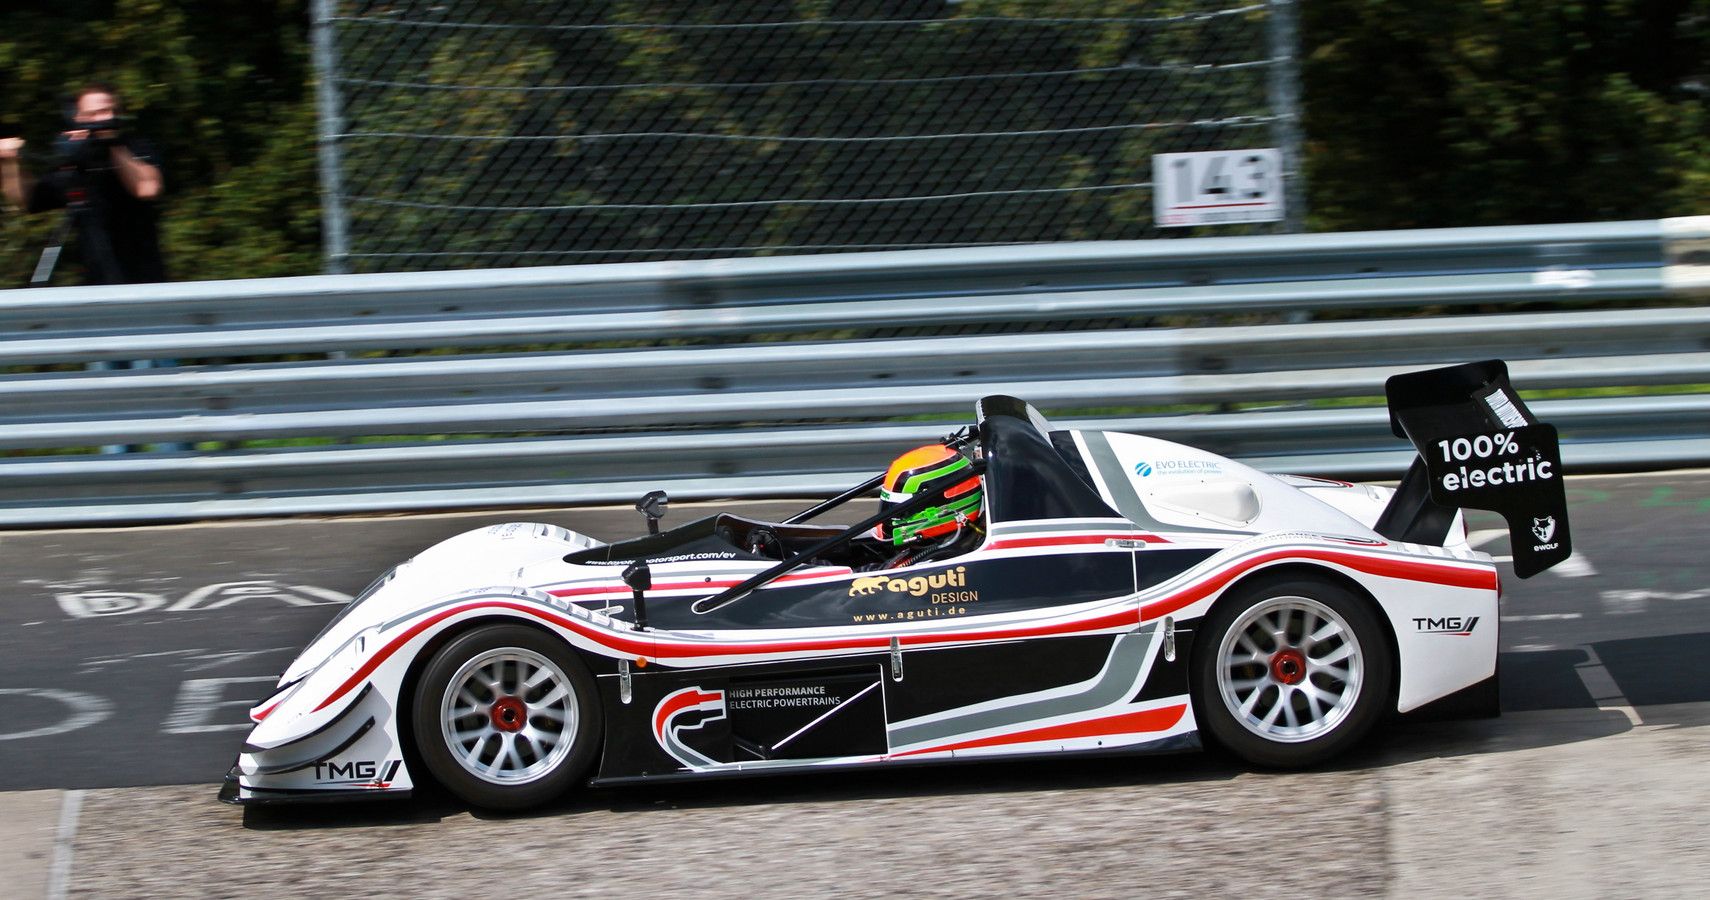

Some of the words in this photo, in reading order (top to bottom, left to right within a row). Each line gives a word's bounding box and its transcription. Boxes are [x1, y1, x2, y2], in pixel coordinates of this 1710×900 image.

[1170, 153, 1272, 202] 143
[1438, 431, 1519, 462] 100%
[1155, 460, 1176, 469] EVO
[1178, 460, 1222, 469] ELECTRIC
[1442, 457, 1553, 491] electric
[887, 566, 966, 597] aguti
[931, 590, 978, 604] DESIGN
[853, 606, 966, 622] www.aguti.de
[729, 688, 753, 698] HIGH
[755, 686, 825, 697] PERFORMANCE
[730, 699, 772, 709] ELECTRIC
[773, 696, 841, 708] POWERTRAINS
